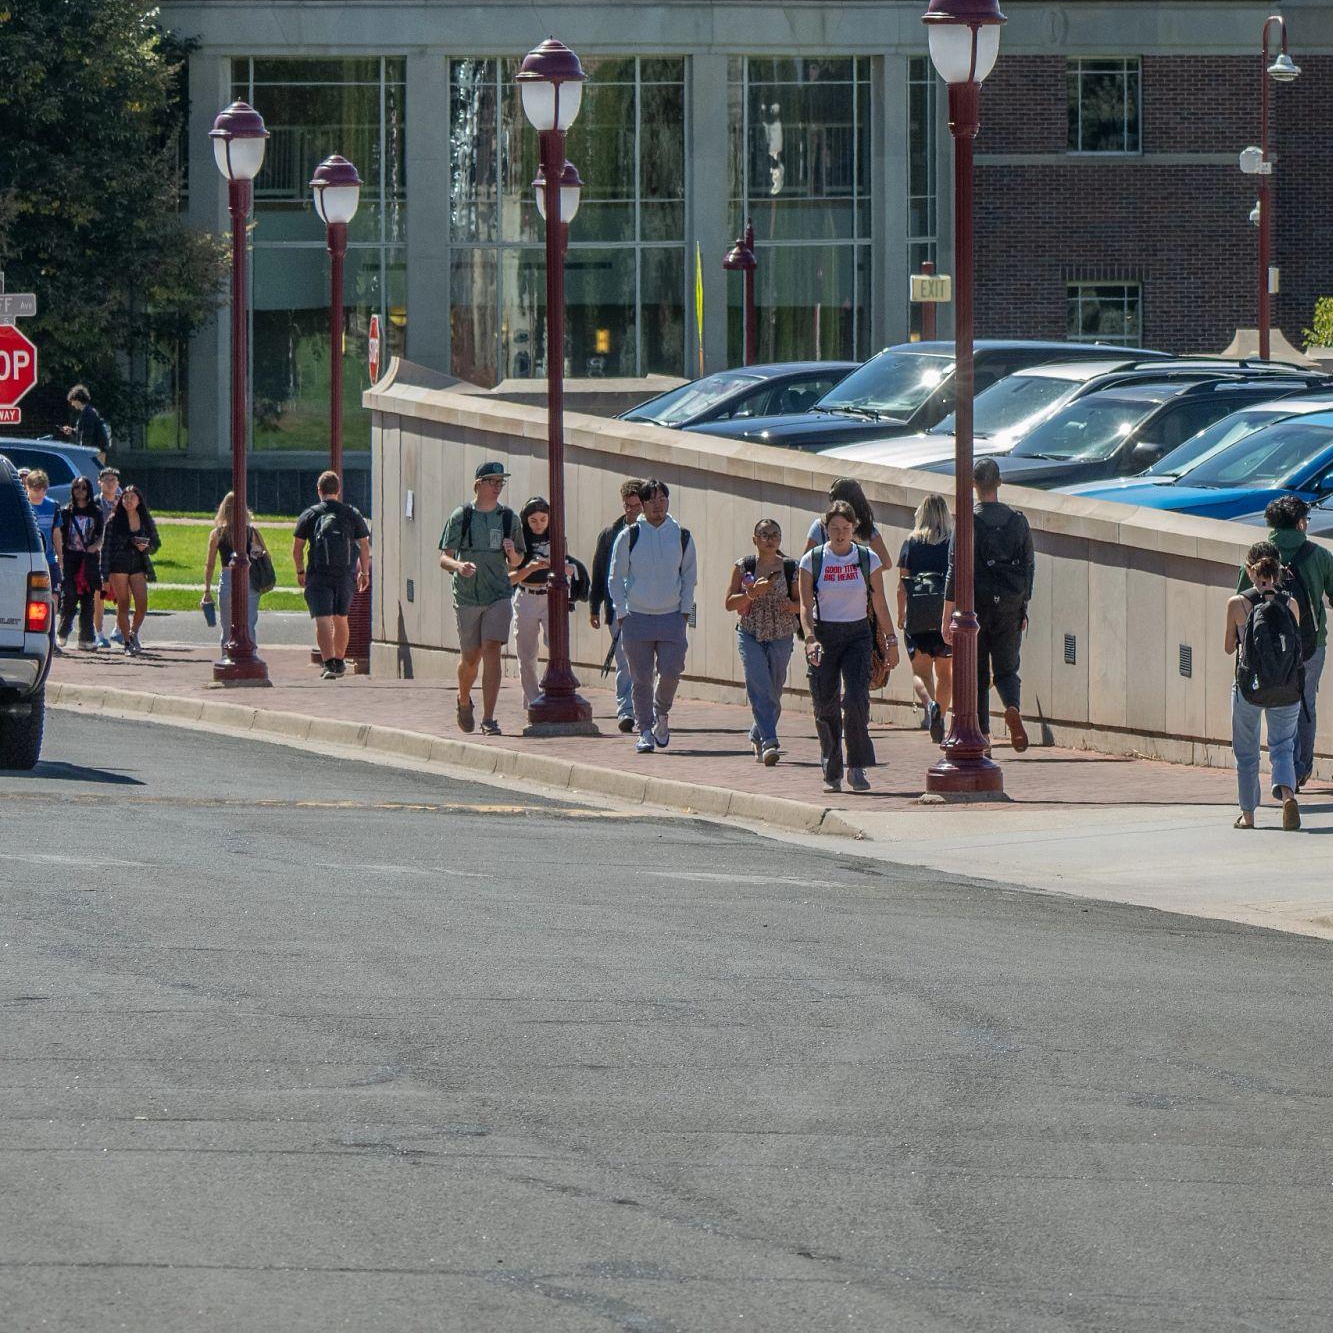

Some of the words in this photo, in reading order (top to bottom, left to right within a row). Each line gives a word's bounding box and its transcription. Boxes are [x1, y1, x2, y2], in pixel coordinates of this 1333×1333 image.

[921, 279, 946, 299] EXIT
[0, 350, 30, 381] OP
[823, 573, 835, 581] BIG
[837, 571, 859, 581] HEART
